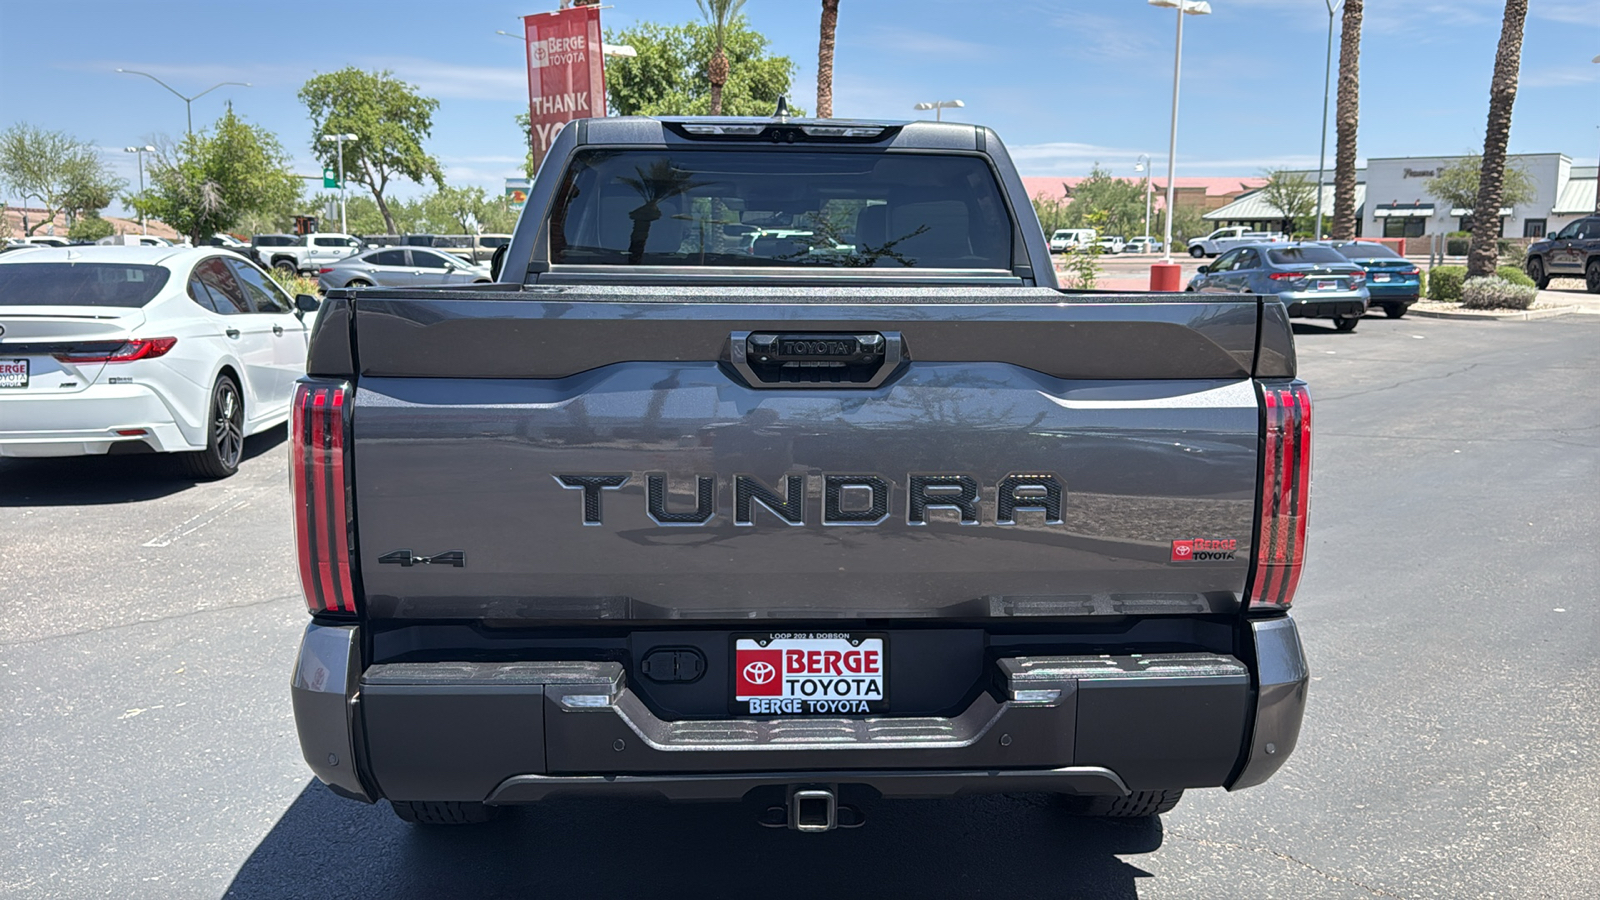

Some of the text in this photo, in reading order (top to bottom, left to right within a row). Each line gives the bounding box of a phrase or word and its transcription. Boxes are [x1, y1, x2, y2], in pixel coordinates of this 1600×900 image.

[548, 36, 585, 52] BERGE
[550, 52, 585, 65] TOYOTA
[533, 92, 588, 115] THANK
[784, 341, 849, 355] TOYOTA
[553, 473, 1065, 527] TUNDRA
[1194, 537, 1237, 551] BERGE
[1192, 551, 1235, 560] TOYOTA
[785, 649, 880, 677] BERGE
[785, 679, 882, 696] TOYOTA
[748, 698, 870, 715] BERGE TOYOTA
